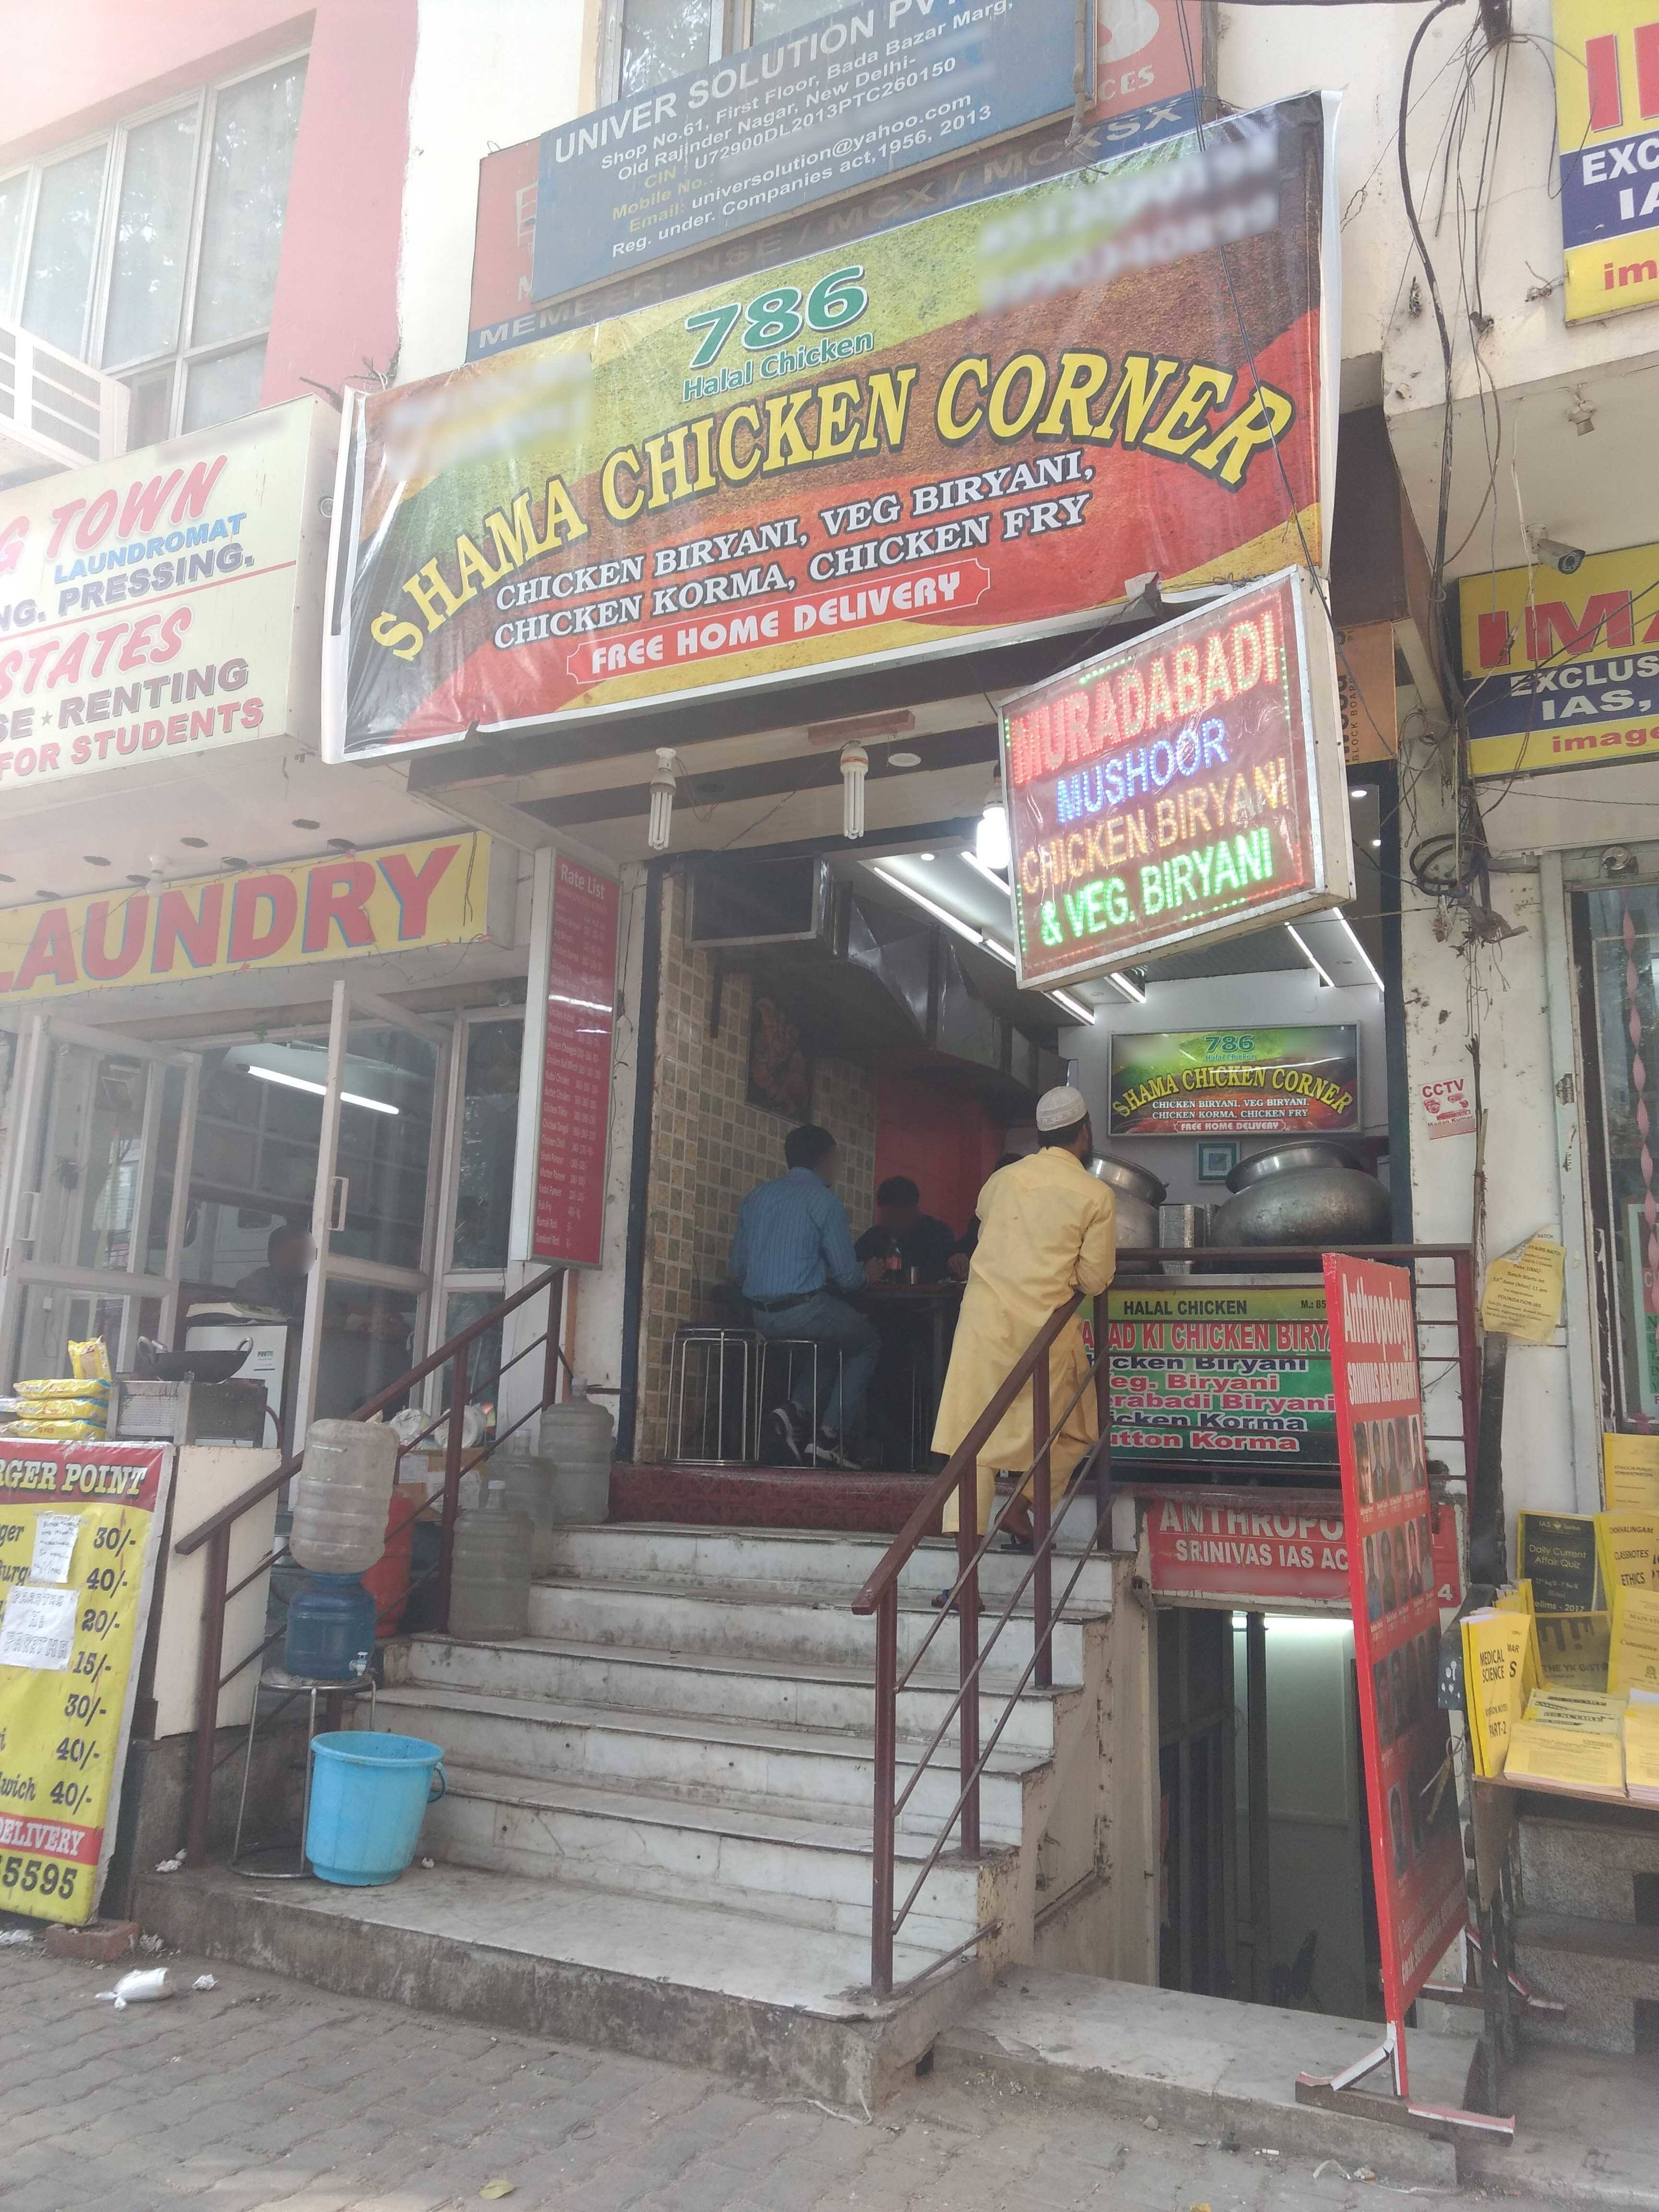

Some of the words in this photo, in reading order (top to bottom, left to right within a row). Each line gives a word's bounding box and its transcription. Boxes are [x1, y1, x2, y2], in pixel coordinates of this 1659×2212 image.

[556, 93, 677, 163] UNIVER
[688, 10, 874, 109] SOLUTION
[601, 144, 647, 169] Shop
[653, 119, 709, 149] No.61,
[716, 96, 759, 124] First
[765, 75, 819, 105] Floor,
[827, 51, 878, 80] Bada
[886, 23, 947, 56] Bazar
[953, 0, 1013, 29] Marg,
[618, 158, 649, 180] Old
[655, 128, 733, 167] Rajinder
[738, 103, 798, 135] Nagar,
[806, 82, 849, 108] New
[856, 55, 916, 88] Delhi-
[629, 202, 685, 233] Email:
[692, 95, 971, 209] universolution@yahoo.com
[645, 166, 677, 189] CIN
[612, 236, 652, 258] Reg.
[658, 211, 715, 240] under.
[722, 167, 833, 216] Companies
[839, 150, 876, 173] act,
[878, 130, 932, 158] 1956,
[939, 105, 991, 137] 2013
[613, 189, 672, 221] Mobile
[685, 265, 869, 370] 786
[683, 361, 754, 402] Halal
[759, 332, 874, 379] Chicken
[47, 454, 228, 561] TOWN
[370, 478, 589, 661] SHAMA
[602, 368, 916, 520] CHICKEN
[937, 353, 1292, 484] CORNER
[496, 556, 644, 610] CHICKEN
[655, 519, 807, 576] BIRYANI,
[820, 495, 900, 535] VEG
[913, 450, 1093, 516] BIRYANI,
[54, 512, 247, 585] LAUNDROMAT
[58, 542, 255, 616] PRESSING.
[494, 594, 642, 648] CHICKEN
[652, 564, 795, 616] KORMA,
[809, 516, 989, 580] CHICKEN
[1002, 493, 1090, 538] FRY
[592, 635, 664, 674] FREE
[677, 611, 778, 656] HOME
[793, 571, 961, 631] DELIVERY
[57, 658, 249, 730] RENTING
[1011, 610, 1278, 786] MURADABADI
[1542, 689, 1652, 721] IAS,
[71, 696, 264, 764] STUDENTS
[1351, 721, 1360, 762] BLOCK
[1056, 717, 1229, 825] MUSHOOR
[1020, 808, 1149, 894] CHICKEN
[1155, 757, 1289, 847] BIRYANI
[561, 864, 585, 890] Rate
[587, 876, 605, 900] List
[1041, 900, 1063, 947] &
[1063, 877, 1135, 938] VEG.
[1140, 826, 1274, 916] BIRYANI
[1205, 1034, 1255, 1053] 786
[1112, 1073, 1179, 1118] SHAMA
[1182, 1065, 1267, 1091] CHICKEN
[1272, 1068, 1354, 1114] CORNER
[1152, 1100, 1196, 1109] CHICKEN
[1198, 1099, 1240, 1108] BIRYANI,
[1243, 1098, 1266, 1107] VEG
[1266, 1097, 1310, 1107] BIRYANI,
[1422, 1078, 1465, 1099] CCTV
[1152, 1111, 1197, 1119] CHICKEN
[1240, 1108, 1286, 1118] CHICKEN
[1288, 1108, 1309, 1117] FRY
[1180, 1121, 1203, 1130] FREE
[1205, 1121, 1233, 1130] HOME
[1236, 1120, 1279, 1130] DELIVERY
[1427, 1119, 1450, 1128] Madan
[1451, 1114, 1474, 1124] Kumar
[1123, 1300, 1172, 1316] HALAL
[1177, 1300, 1248, 1315] CHICKEN
[1498, 1294, 1533, 1306] FOUNDATION
[1342, 1273, 1413, 1361] Anthropology
[1143, 1323, 1165, 1350] KI
[1171, 1322, 1271, 1351] CHICKEN
[1196, 1356, 1309, 1374] Biryani
[1166, 1372, 1280, 1393] Biryani
[1347, 1362, 1381, 1406] SRINIVAS
[1221, 1394, 1336, 1415] Biryani
[1200, 1413, 1308, 1432] Korma
[1190, 1431, 1300, 1452] Korma
[0, 1459, 58, 1491] GER
[62, 1462, 148, 1495] POINT
[93, 1527, 136, 1558] 30/-
[1176, 1539, 1273, 1566] SRINIVAS
[1280, 1547, 1315, 1569] IAS
[1528, 1544, 1550, 1555] Daily
[1552, 1547, 1587, 1560] Current
[1535, 1556, 1558, 1566] Affair
[1560, 1559, 1581, 1570] Quiz
[1621, 1572, 1646, 1586] ETHICS
[86, 1567, 128, 1599] 40/-
[1437, 1584, 1453, 1601] 4
[1535, 1599, 1557, 1610] elims
[81, 1609, 120, 1642] 20/-
[72, 1651, 112, 1683] 15/-
[1479, 1648, 1505, 1666] MEDICAL
[1509, 1660, 1517, 1678] S
[1482, 1665, 1505, 1683] SCIENCE
[64, 1694, 107, 1728] 30/-
[1489, 1720, 1507, 1739] PART-2
[56, 1737, 100, 1771] 40/-
[49, 1780, 93, 1815] 40/-
